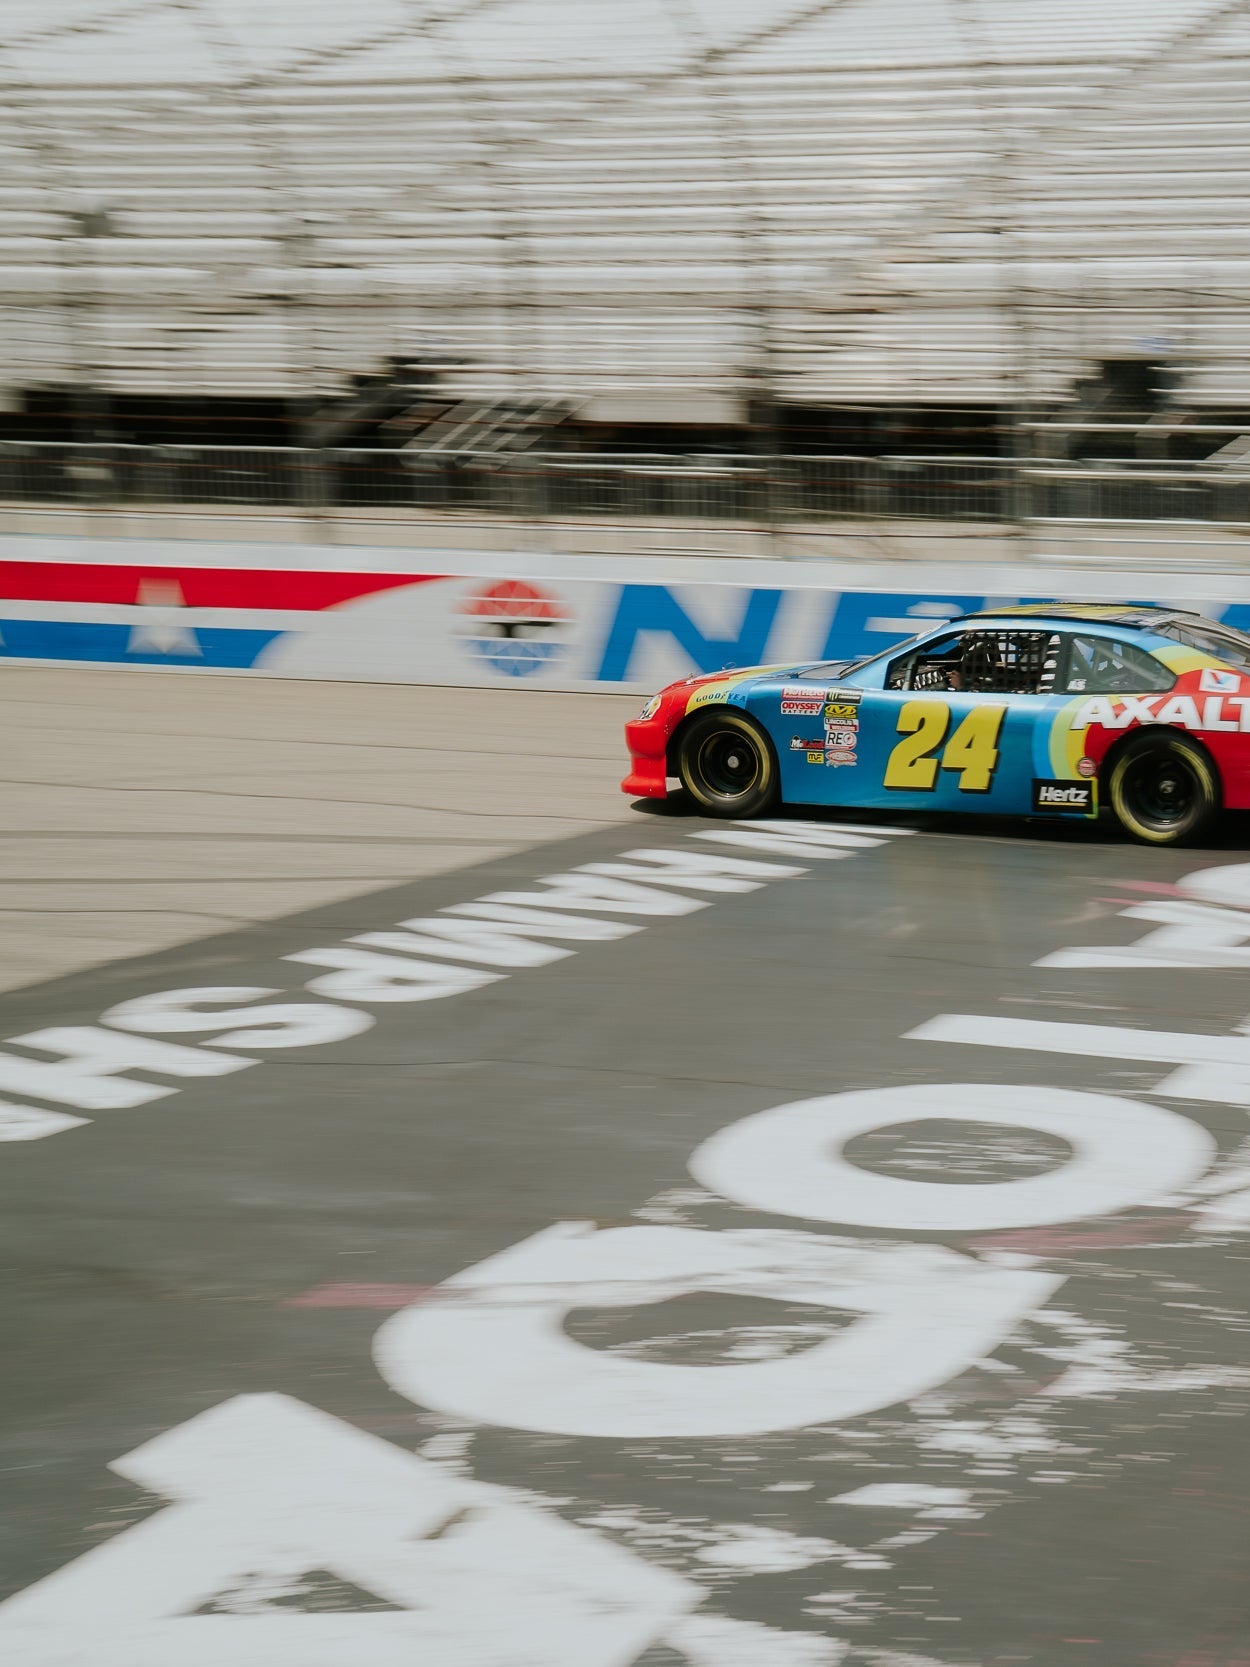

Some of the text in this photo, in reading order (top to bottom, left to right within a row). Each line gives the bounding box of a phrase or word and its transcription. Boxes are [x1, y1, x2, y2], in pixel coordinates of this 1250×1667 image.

[782, 702, 821, 710] ODYSSEY
[883, 699, 1009, 793] 24
[1038, 786, 1089, 803] Hertz
